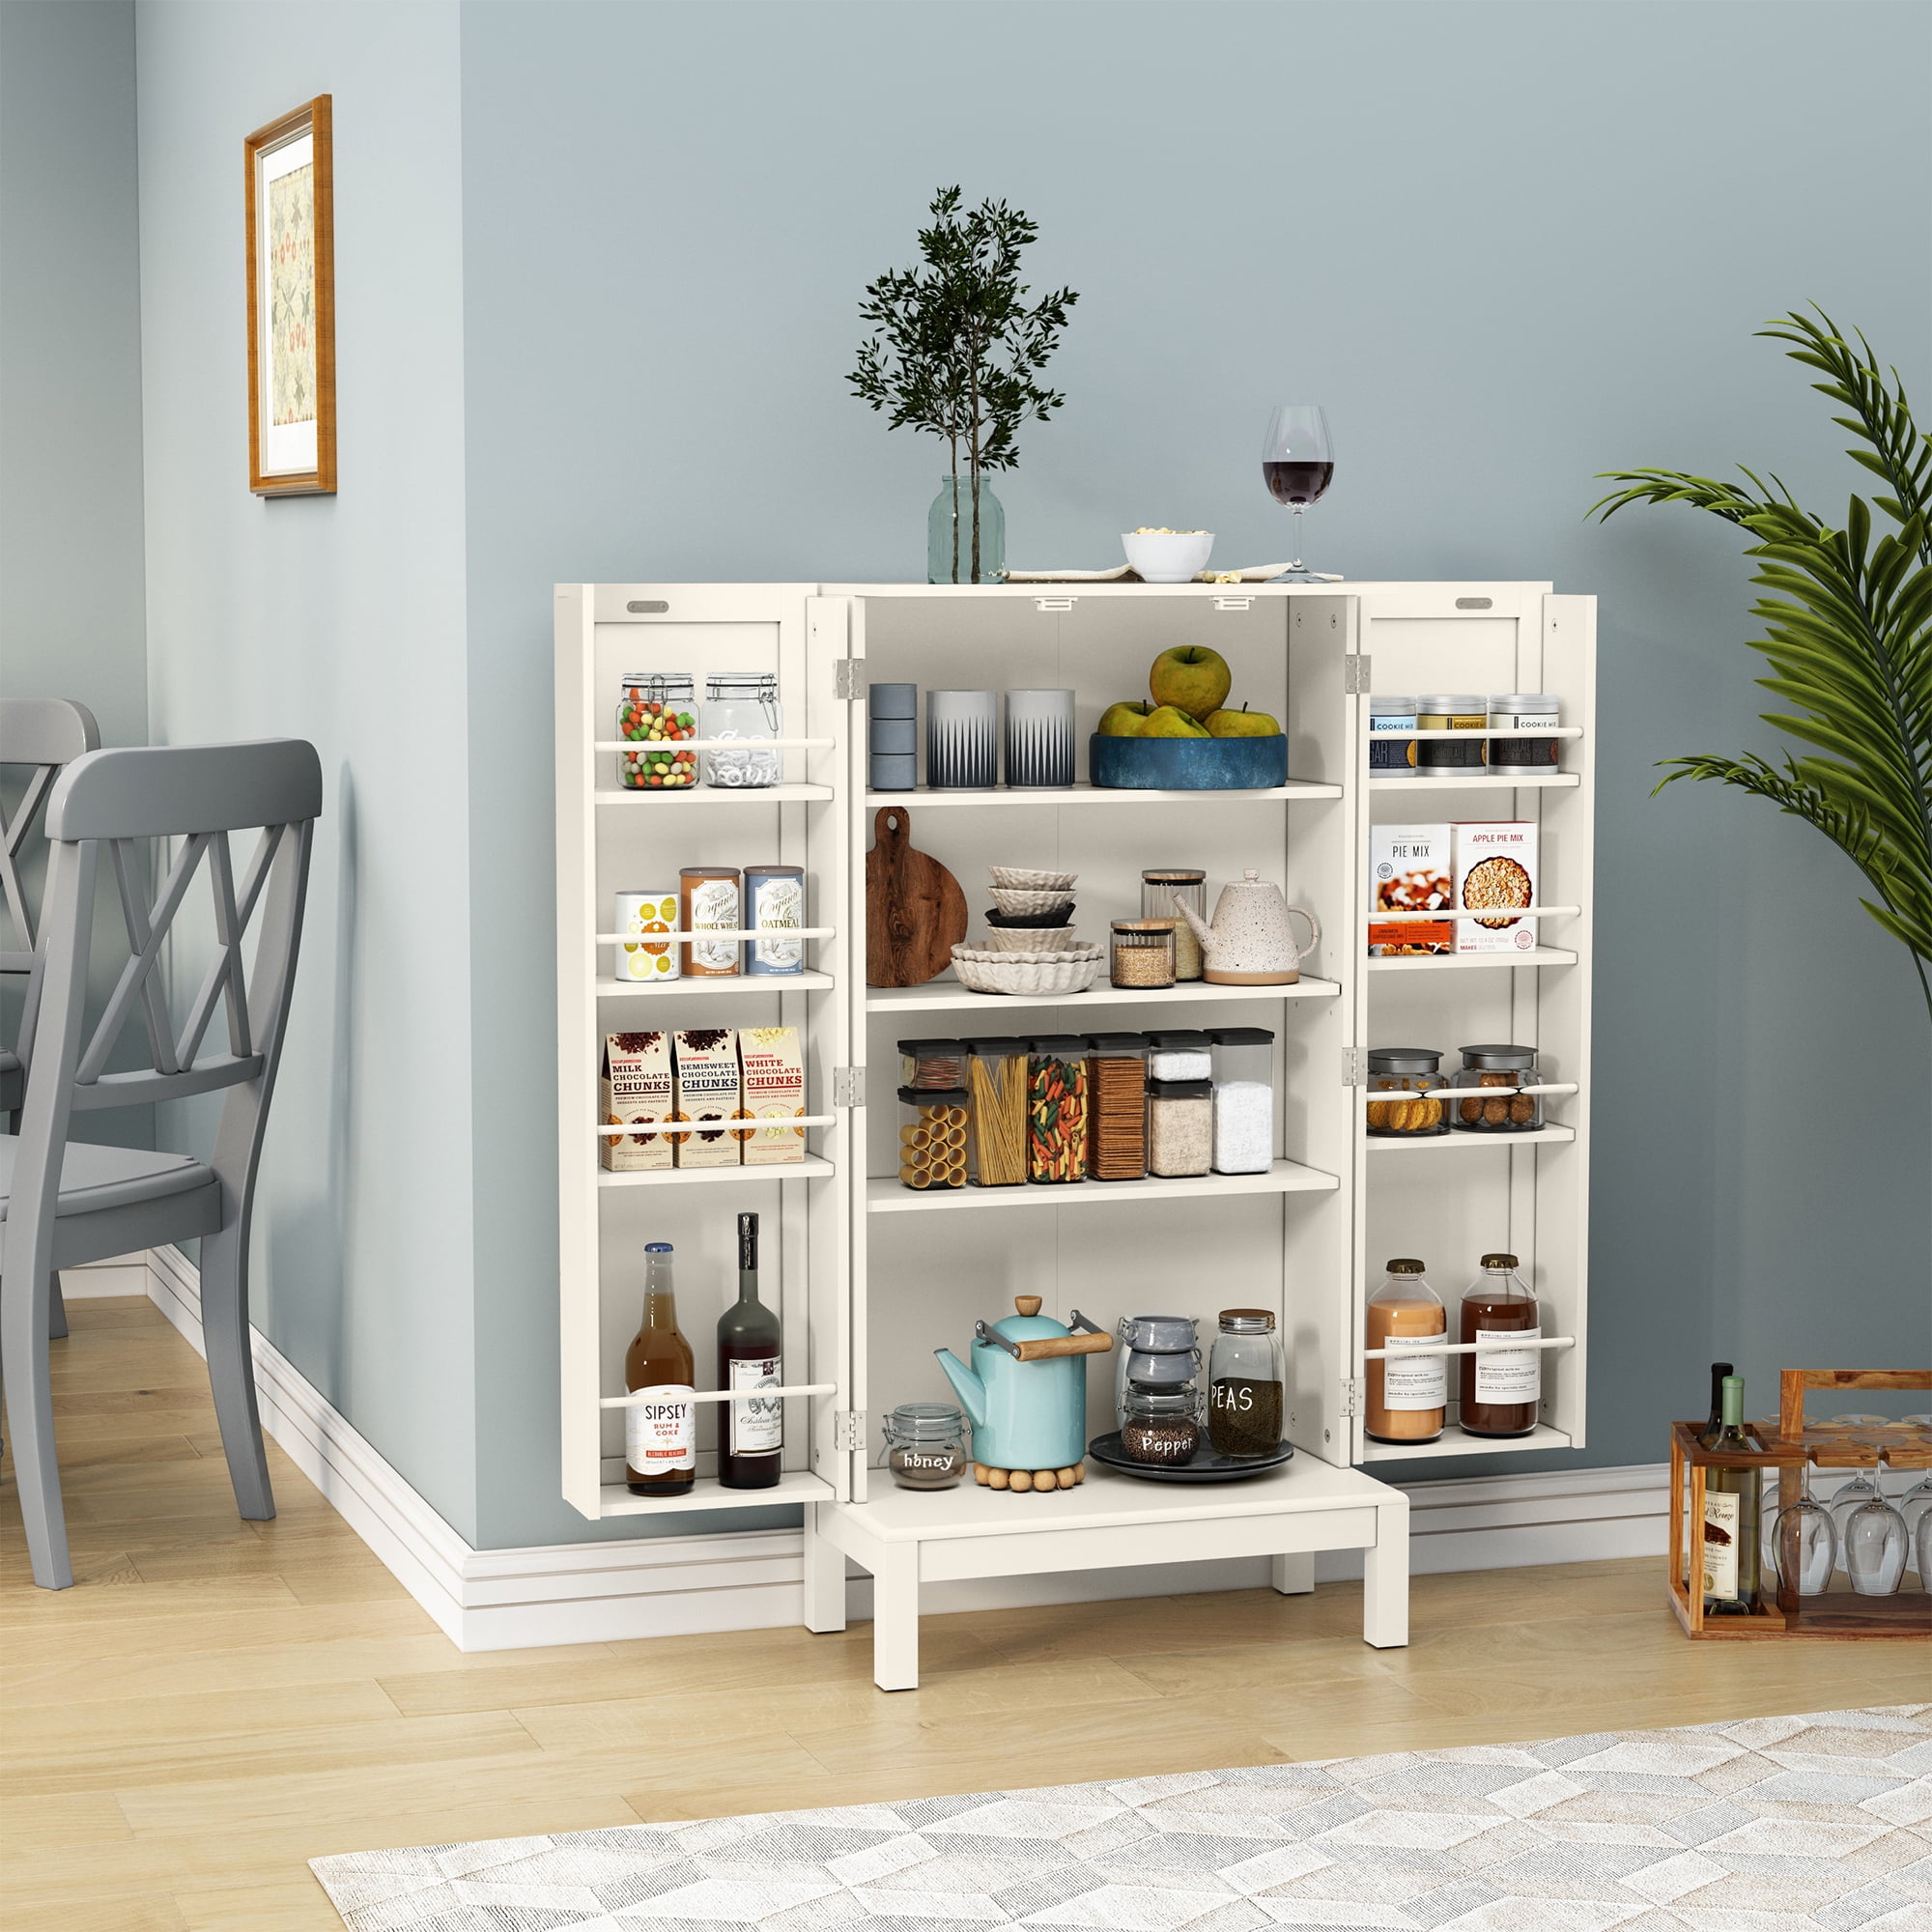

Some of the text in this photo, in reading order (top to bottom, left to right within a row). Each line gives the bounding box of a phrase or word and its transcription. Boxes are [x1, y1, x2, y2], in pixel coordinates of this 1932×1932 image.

[1496, 834, 1508, 842] PIE
[1392, 845, 1430, 858] PIE MIX
[761, 919, 800, 928] OATMEAL
[680, 1062, 736, 1070] SEMISWEET
[745, 1059, 783, 1067] WHITE
[682, 1078, 738, 1089] CHUNKS
[747, 1075, 802, 1086] CHUNKS
[613, 1081, 670, 1092] CHUNKS
[1211, 1384, 1253, 1411] PEAS
[645, 1403, 687, 1420] SIPSEY
[1142, 1436, 1193, 1457] Pepper
[904, 1453, 953, 1471] honey
